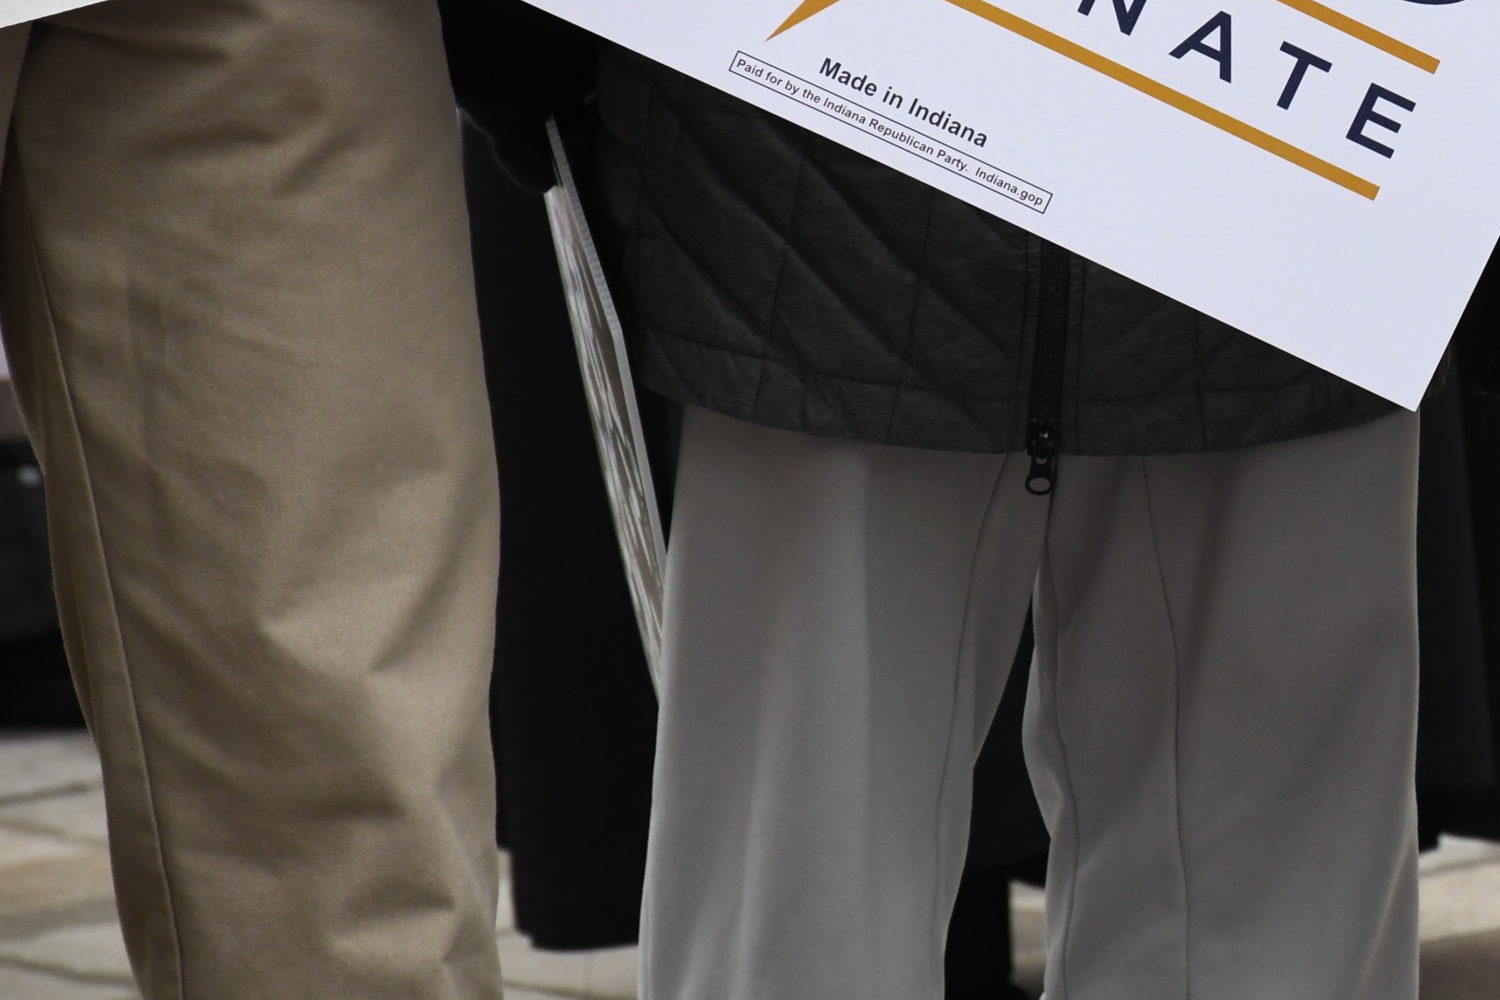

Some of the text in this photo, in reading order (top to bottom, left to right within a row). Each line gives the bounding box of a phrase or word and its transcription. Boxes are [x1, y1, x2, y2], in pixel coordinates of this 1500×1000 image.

[736, 58, 1043, 206] Paid for by the Indiana Republican Party. Indiana.gop
[819, 57, 988, 148] Made in Indiana
